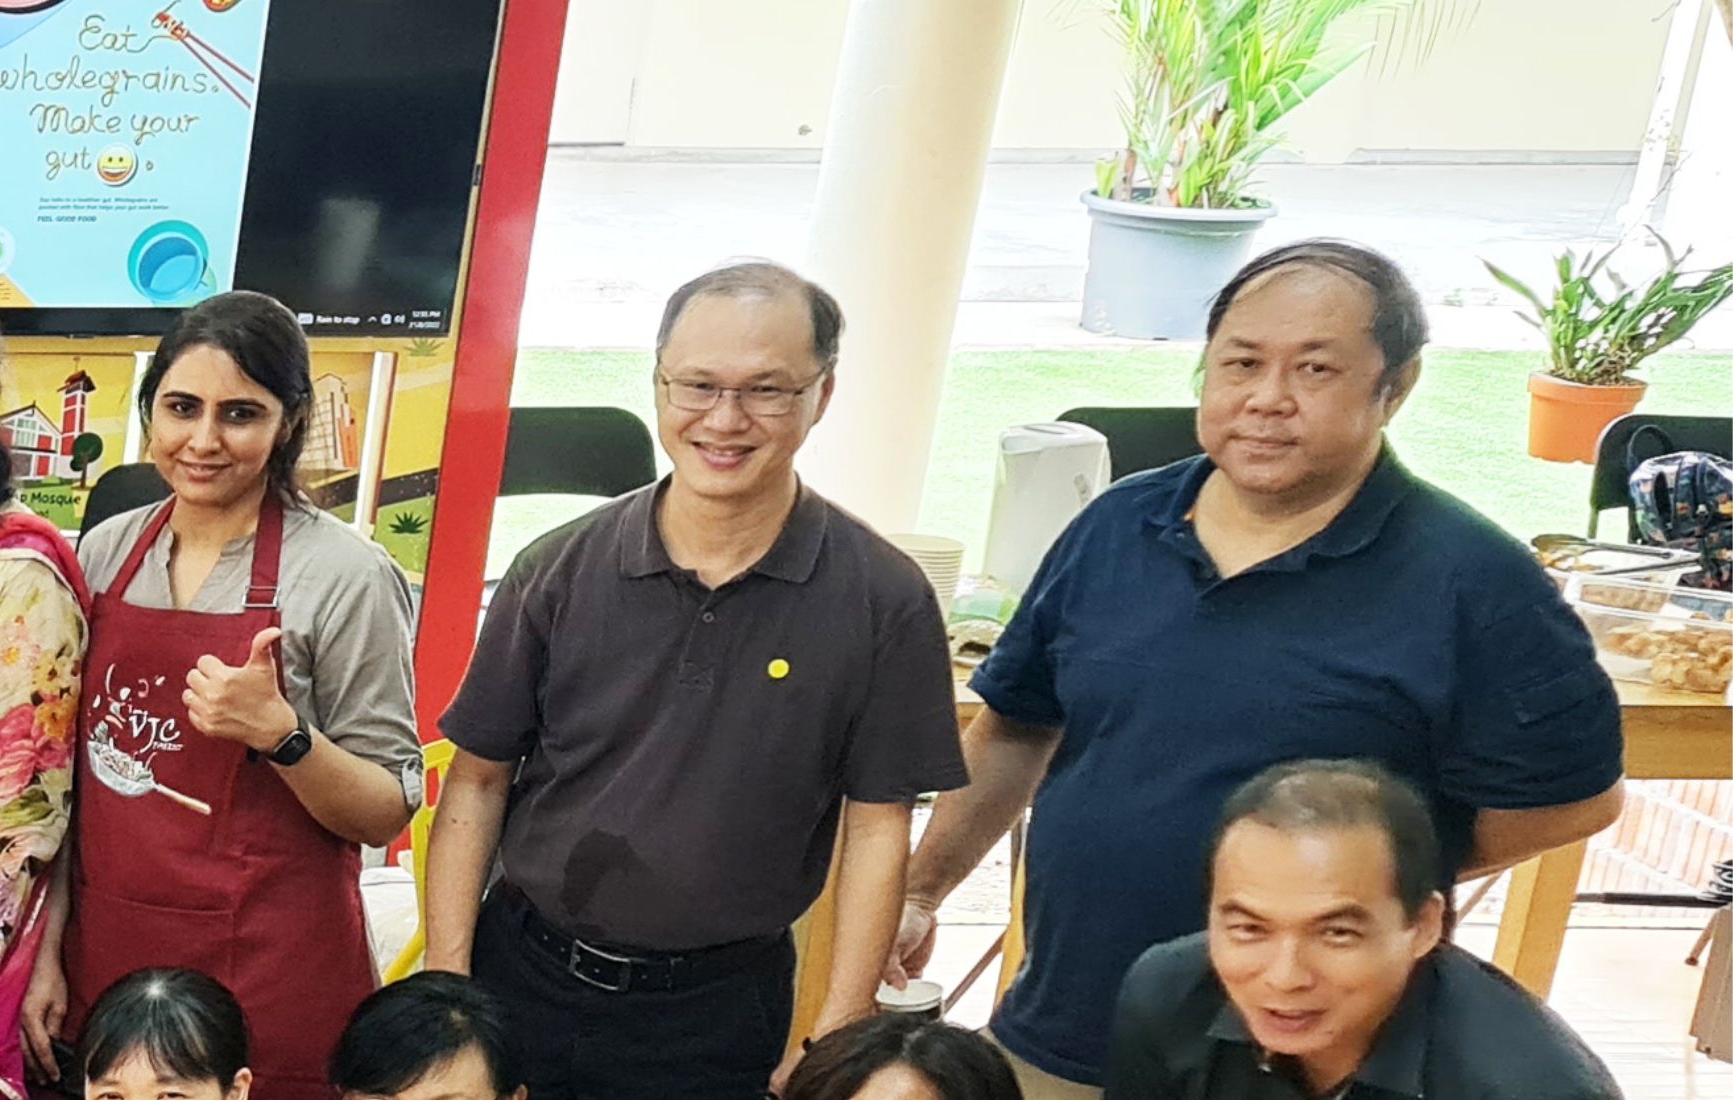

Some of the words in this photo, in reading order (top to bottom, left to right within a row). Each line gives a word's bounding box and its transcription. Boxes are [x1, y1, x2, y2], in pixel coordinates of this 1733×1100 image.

[79, 14, 150, 53] Eat
[29, 103, 120, 134] Make
[130, 112, 201, 145] your
[45, 147, 91, 180] gut
[30, 492, 81, 506] Mosque
[128, 711, 181, 753] VJC
